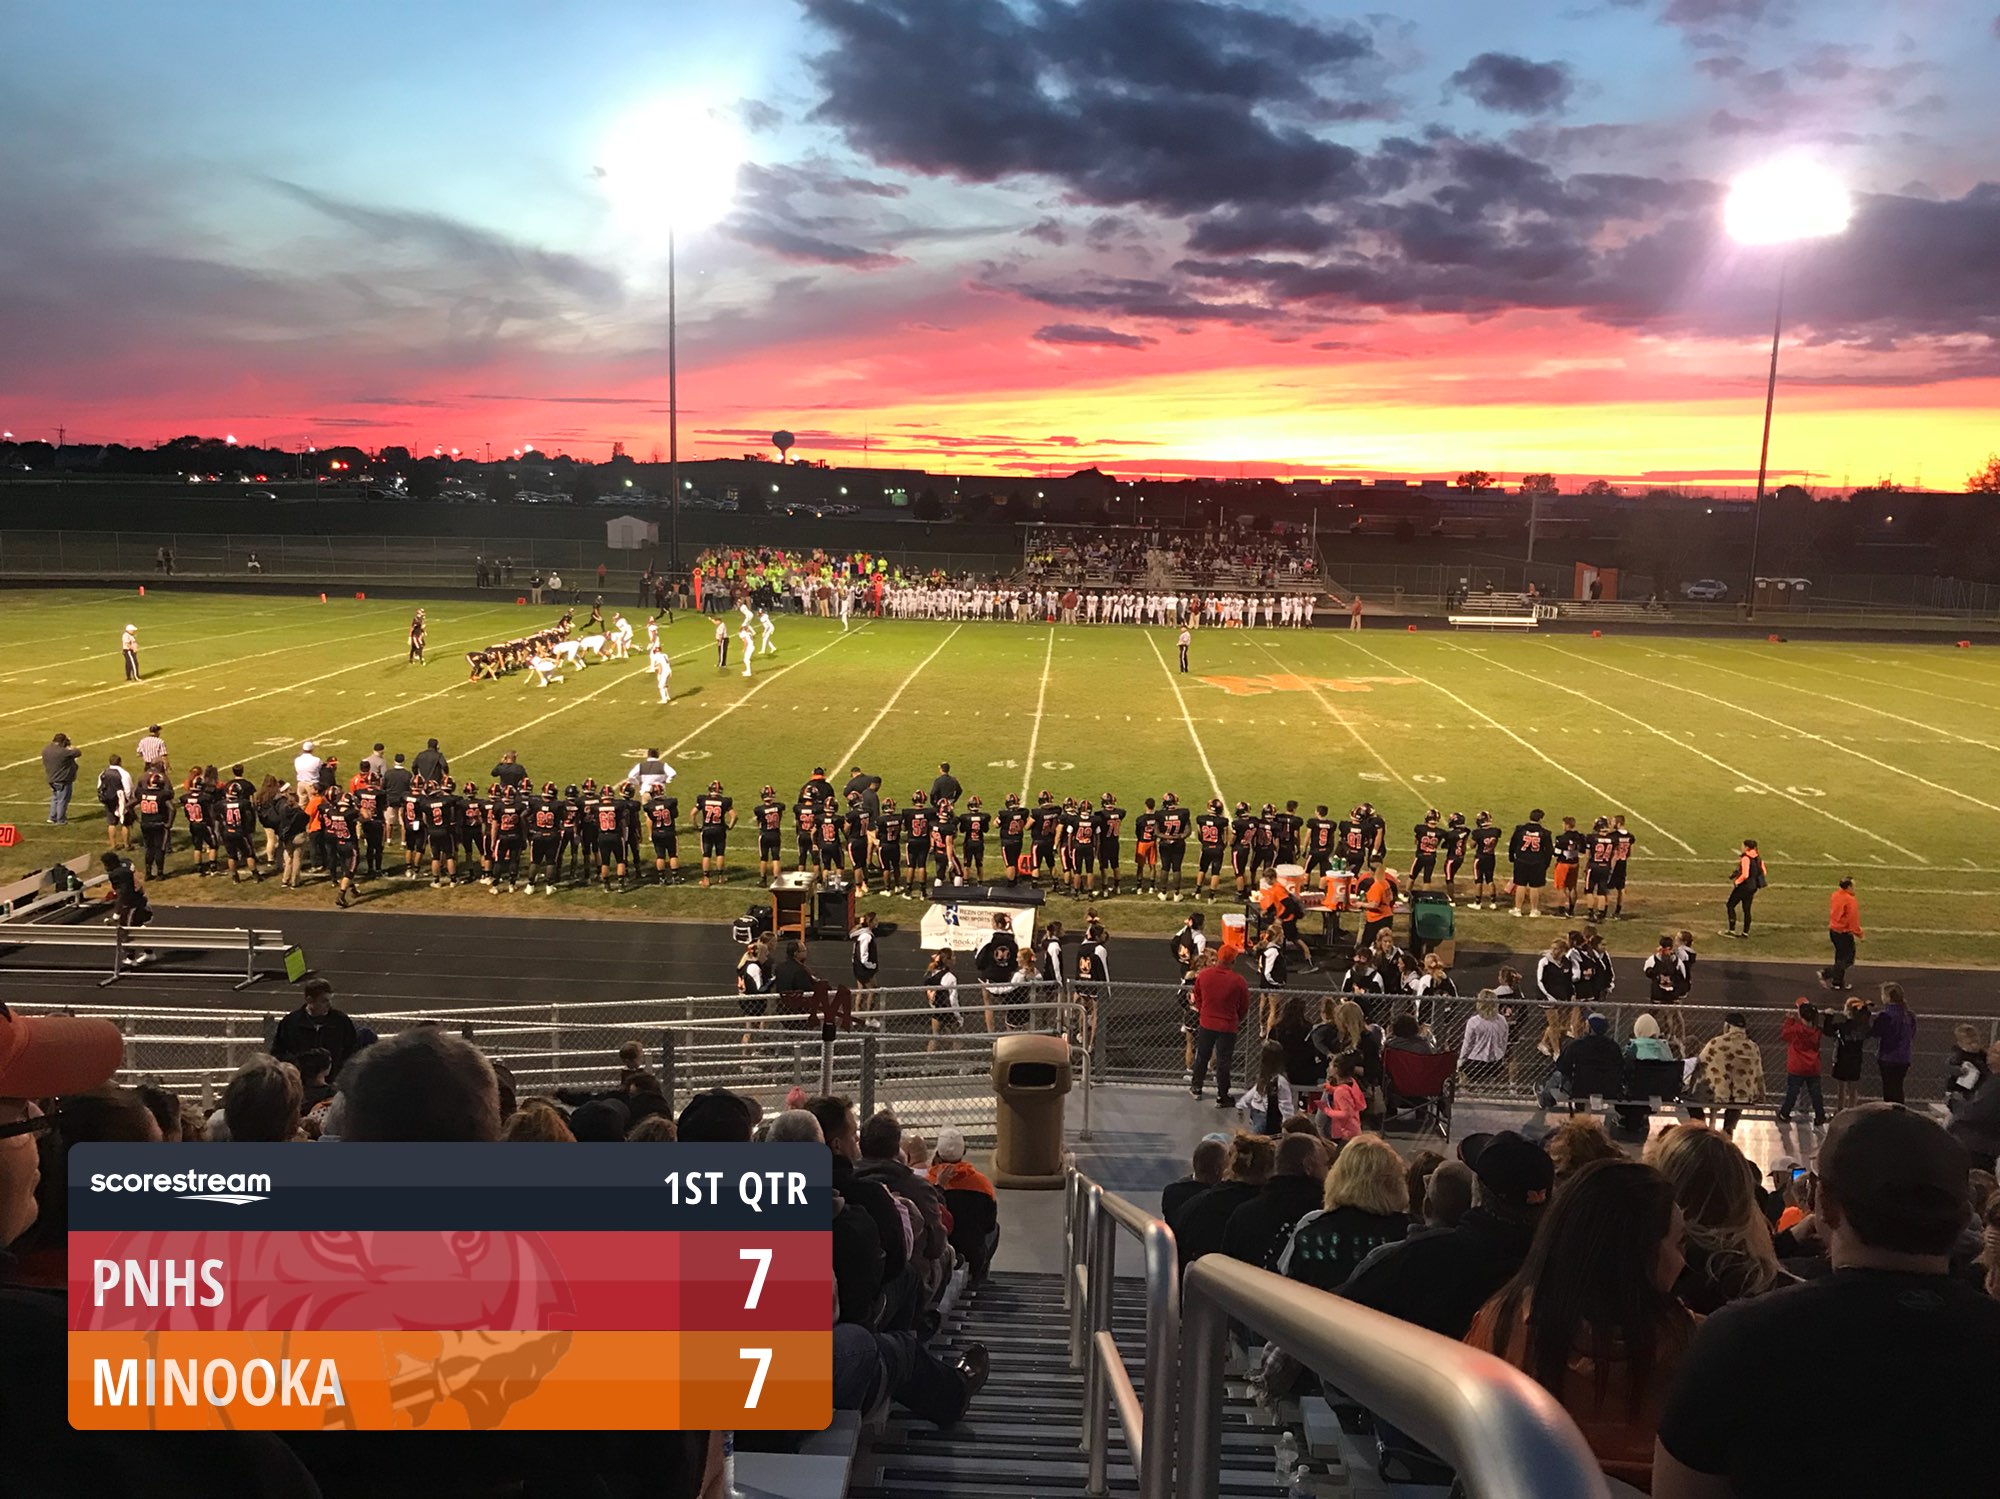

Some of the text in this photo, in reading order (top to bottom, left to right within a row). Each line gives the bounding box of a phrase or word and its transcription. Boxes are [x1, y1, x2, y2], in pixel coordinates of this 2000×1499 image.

[705, 805, 722, 823] 72
[1164, 820, 1181, 836] 77
[1521, 835, 1541, 852] 75
[1594, 843, 1613, 862] 24
